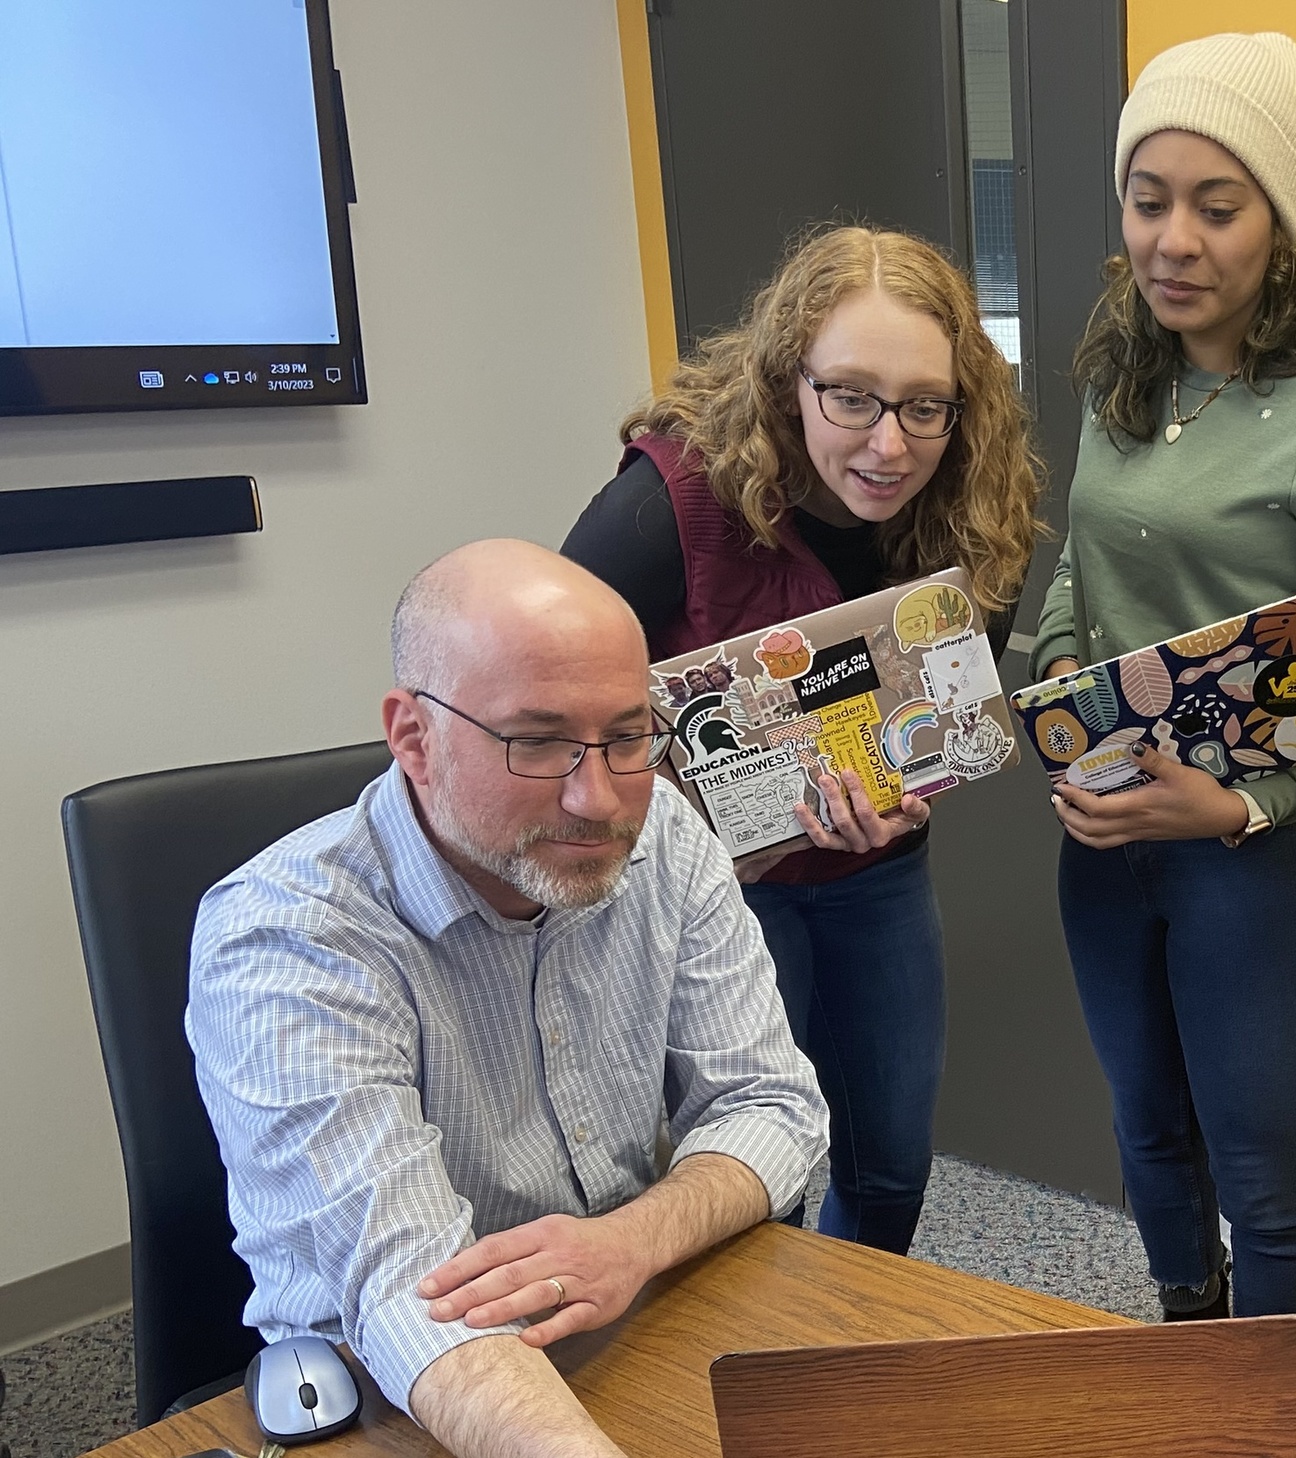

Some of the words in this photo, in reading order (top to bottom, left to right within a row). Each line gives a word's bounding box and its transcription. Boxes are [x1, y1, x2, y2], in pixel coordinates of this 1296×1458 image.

[271, 364, 290, 374] 2:39
[292, 363, 307, 374] PM
[268, 380, 314, 391] 3/10/2023
[935, 633, 972, 650] catterplot
[801, 672, 824, 687] YOU
[827, 659, 848, 677] ARE
[850, 652, 867, 664] ON
[800, 673, 839, 697] NATIVE
[841, 661, 870, 679] LAND
[820, 703, 868, 725] Leaders
[965, 702, 978, 711] cats
[836, 713, 866, 726] Hawkeyes
[779, 732, 817, 756] Vols
[682, 746, 760, 779] EDUCATION
[858, 722, 888, 788] EDUCATION
[860, 756, 867, 764] OF
[982, 763, 995, 771] ON
[994, 740, 1012, 764] LOVE
[1078, 748, 1127, 772] IOWA
[1108, 761, 1130, 771] Education
[699, 772, 728, 790] THE
[864, 766, 877, 792] COLLEGE
[757, 792, 772, 800] CHEESE
[729, 819, 746, 827] KANSAS
